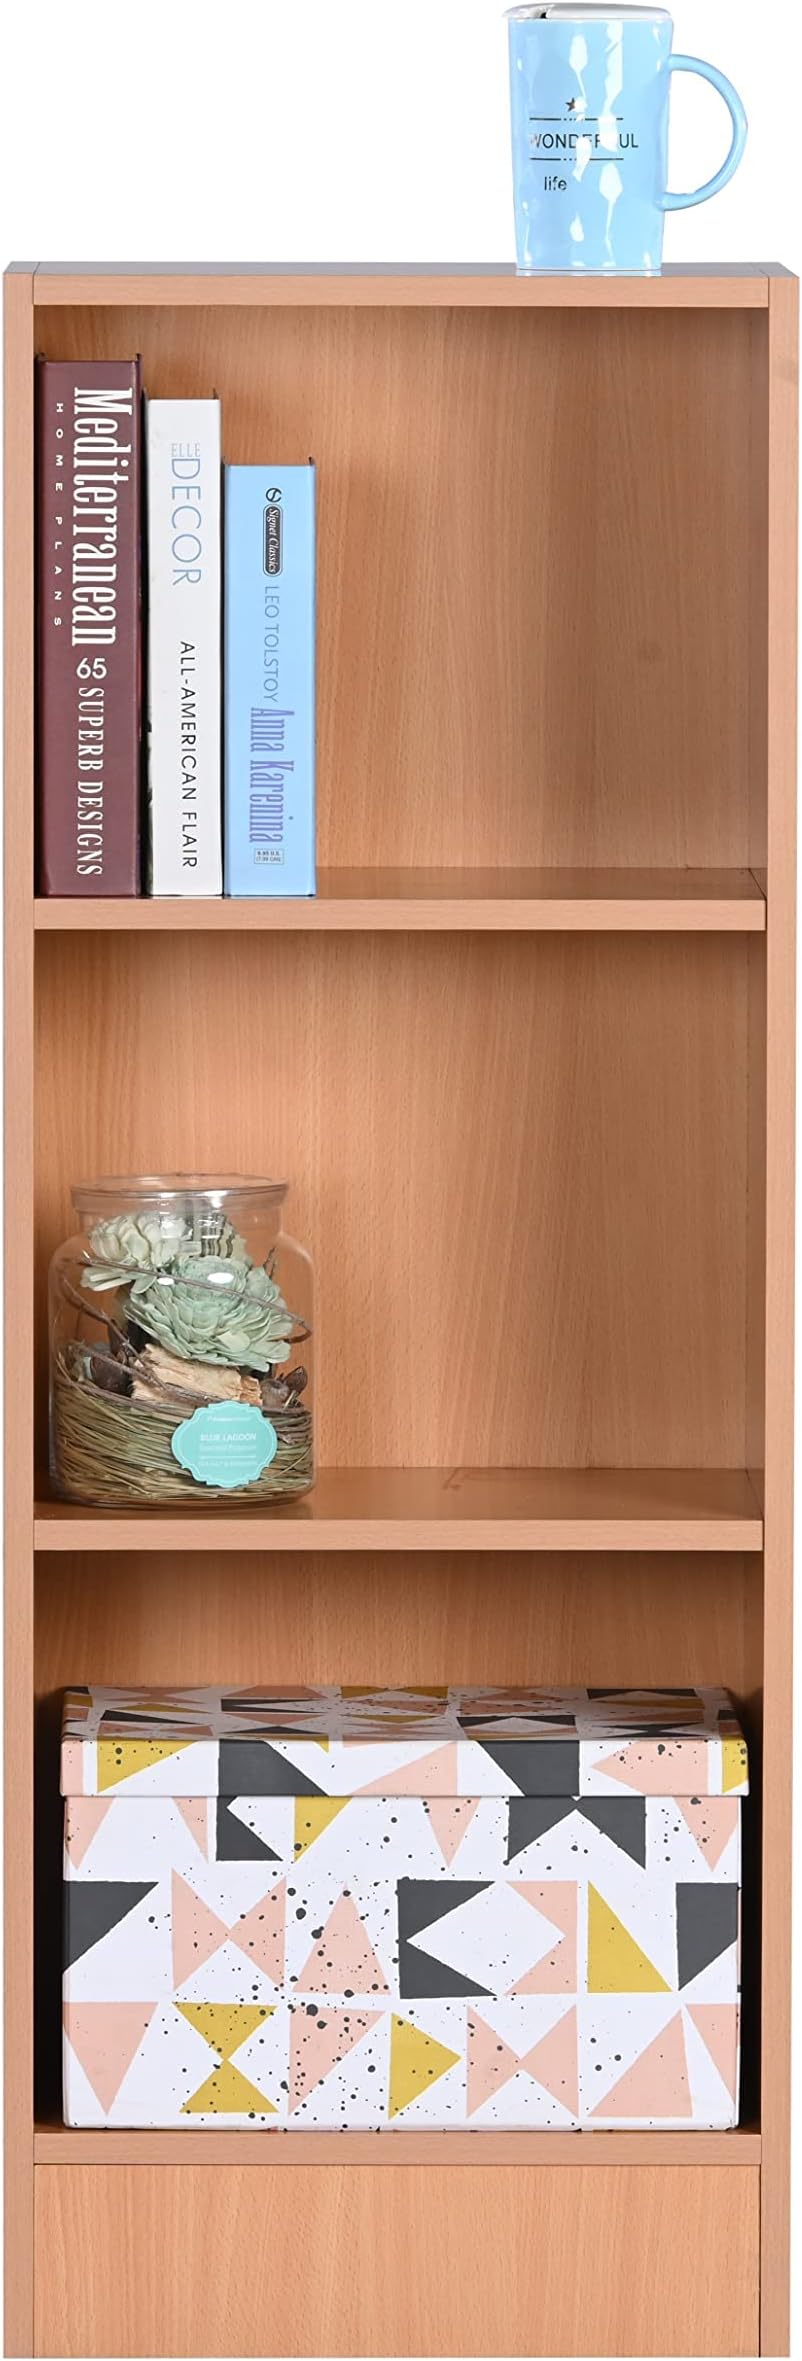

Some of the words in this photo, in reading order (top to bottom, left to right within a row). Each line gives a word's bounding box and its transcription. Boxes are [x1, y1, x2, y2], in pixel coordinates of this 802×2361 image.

[531, 133, 639, 149] WONDUL
[544, 176, 567, 191] life
[55, 402, 64, 491] HOME
[171, 443, 201, 458] ELLE
[72, 387, 133, 647] Mediterranean
[171, 458, 202, 586] DECOR
[268, 537, 279, 573] Classics
[54, 516, 63, 625] PLANS
[264, 586, 280, 618] LEO
[76, 657, 107, 679] 65
[263, 623, 280, 703] TOLSTOY
[77, 687, 104, 771] SUPERB
[180, 641, 198, 800] ALL-AMERICAN
[250, 707, 295, 752] Anna
[76, 781, 104, 875] DESIGNS
[182, 811, 198, 868] FLAIR
[249, 760, 295, 844] Karenina
